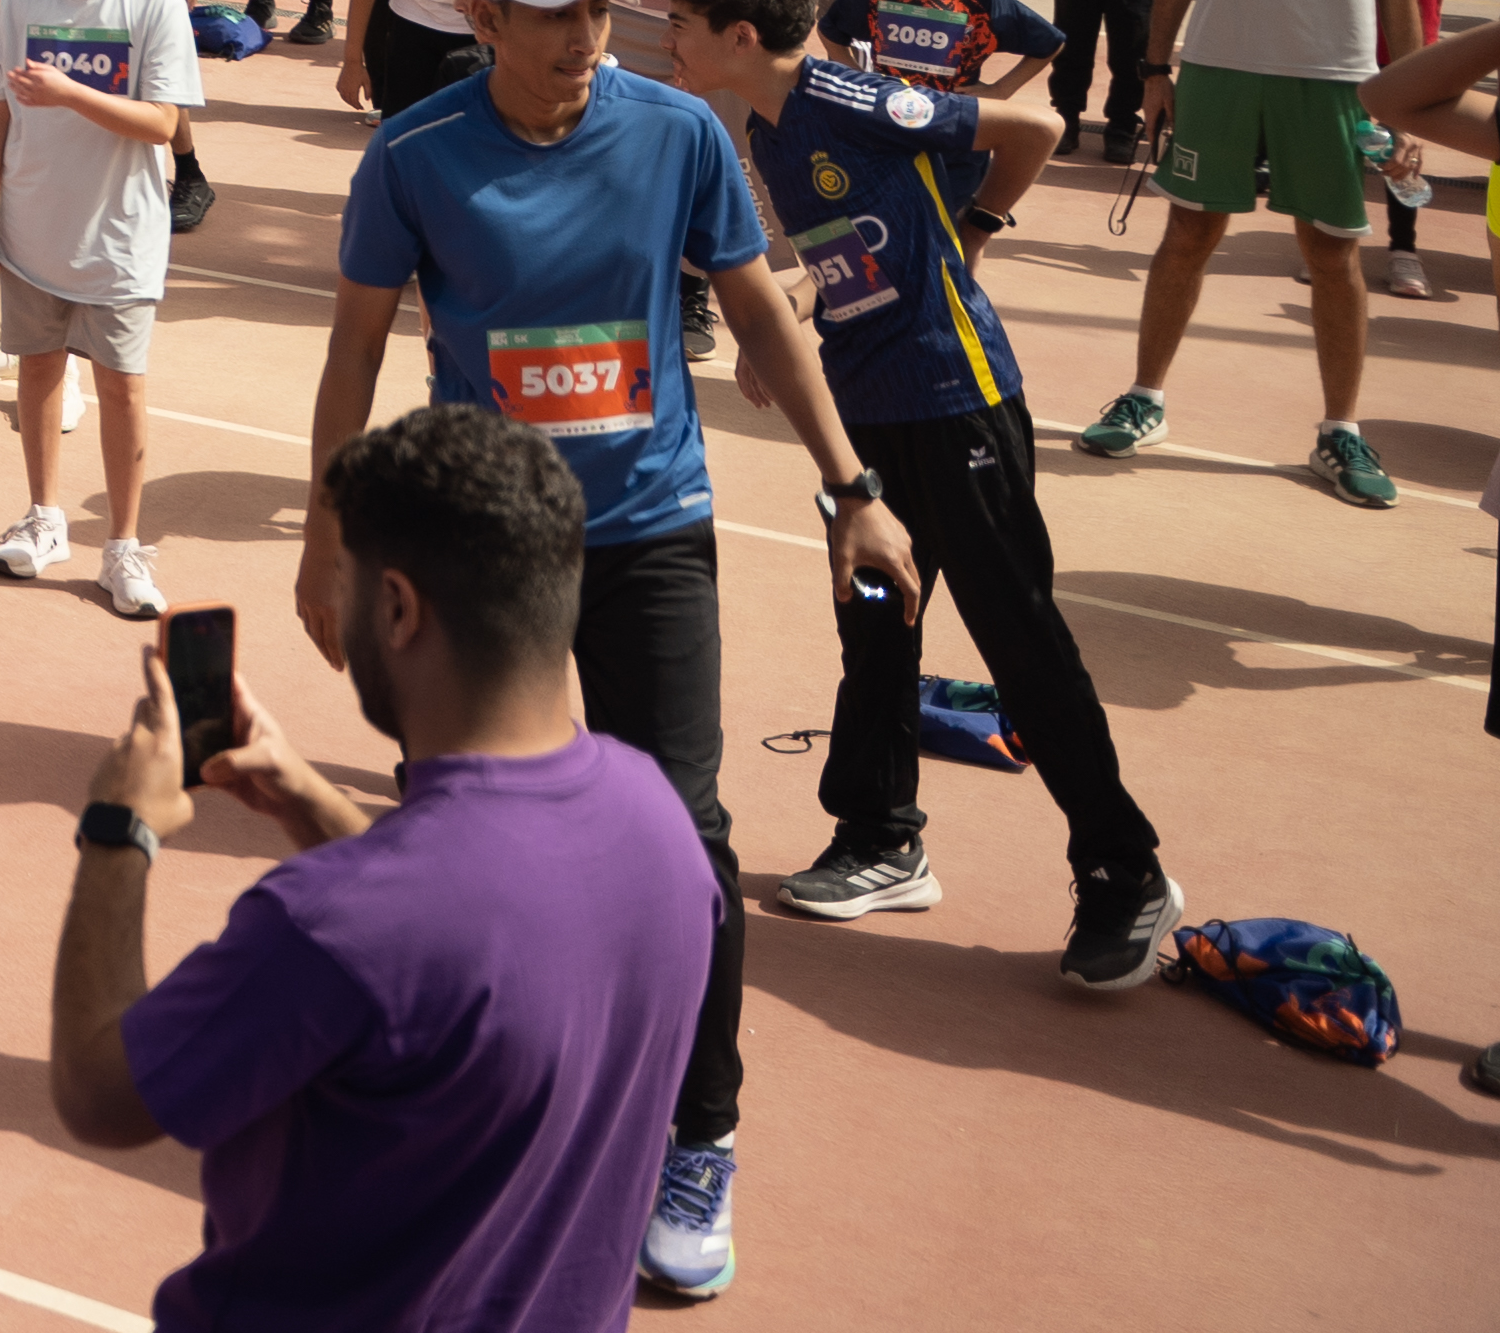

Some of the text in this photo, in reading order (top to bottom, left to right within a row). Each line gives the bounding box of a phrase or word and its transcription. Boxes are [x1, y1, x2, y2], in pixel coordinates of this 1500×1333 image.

[887, 23, 949, 50] 2089
[40, 50, 112, 76] 2040
[520, 358, 622, 397] 5037
